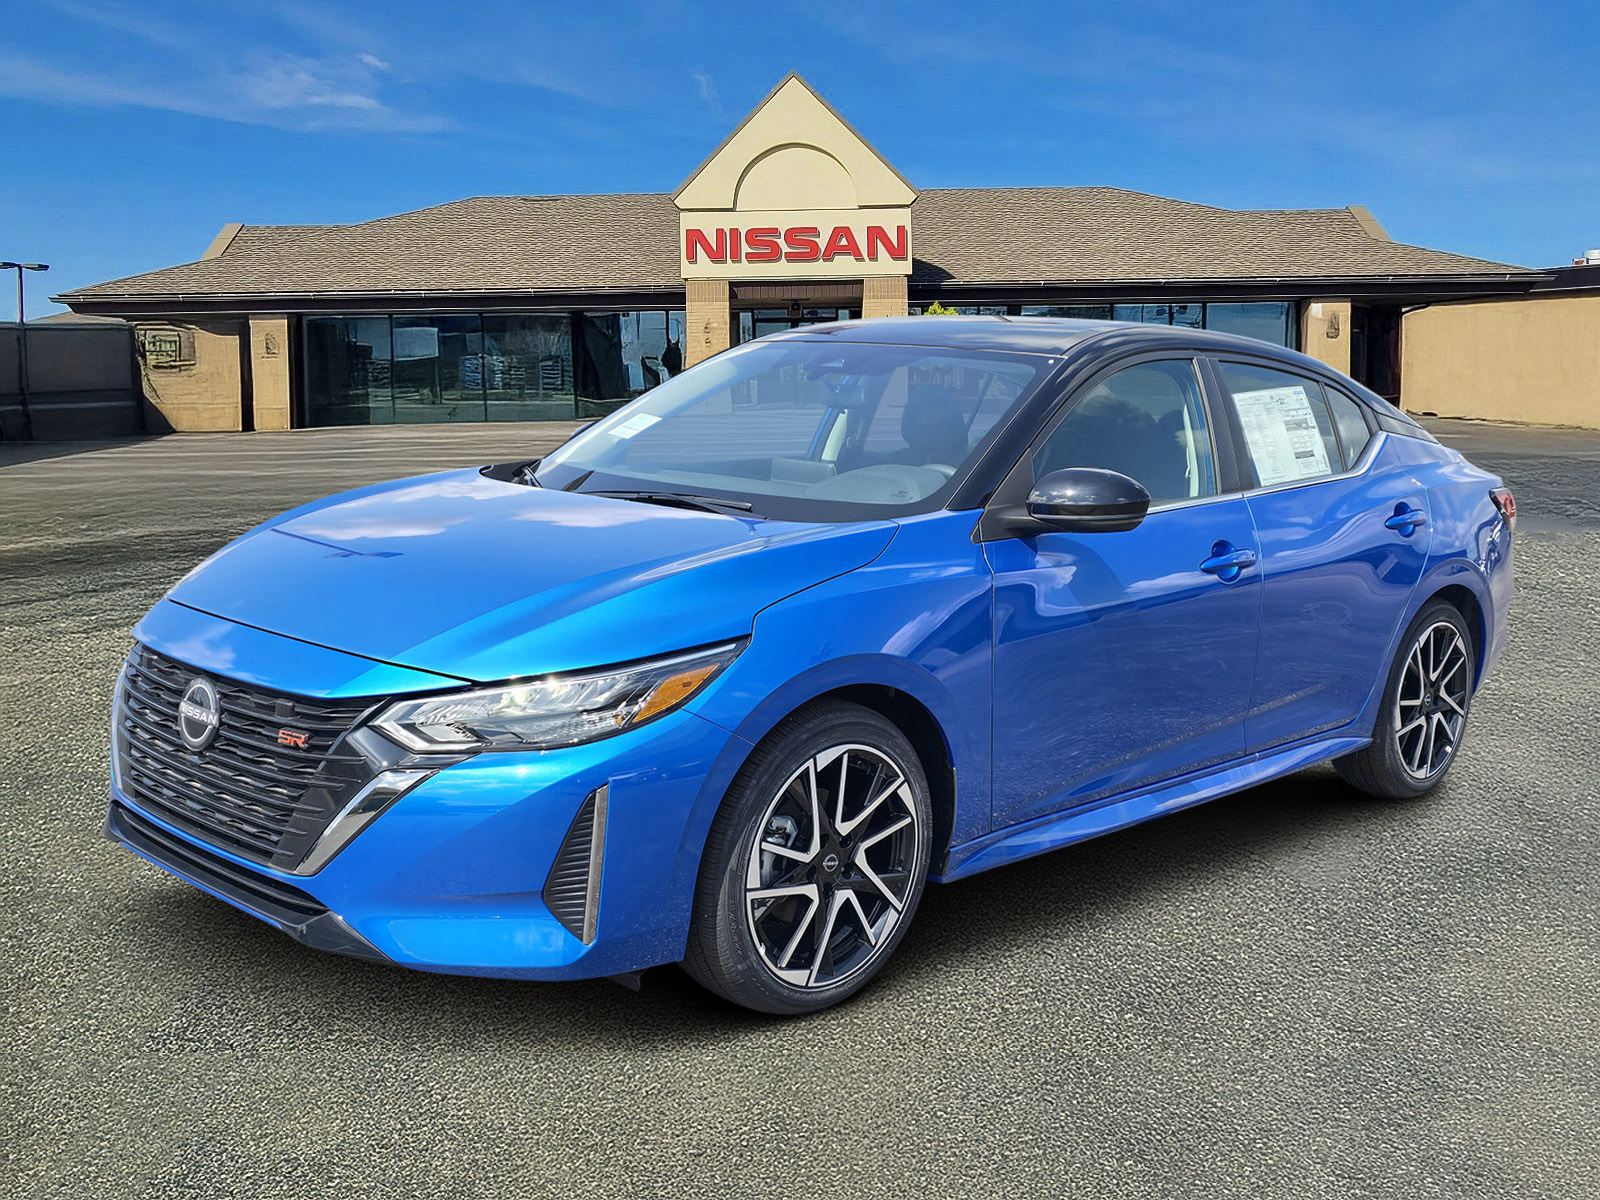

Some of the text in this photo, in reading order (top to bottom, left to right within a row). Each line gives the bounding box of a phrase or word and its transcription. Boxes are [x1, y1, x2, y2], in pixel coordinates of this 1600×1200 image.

[685, 225, 908, 264] NISSAN
[180, 701, 217, 725] NISSAN
[277, 729, 308, 749] SR
